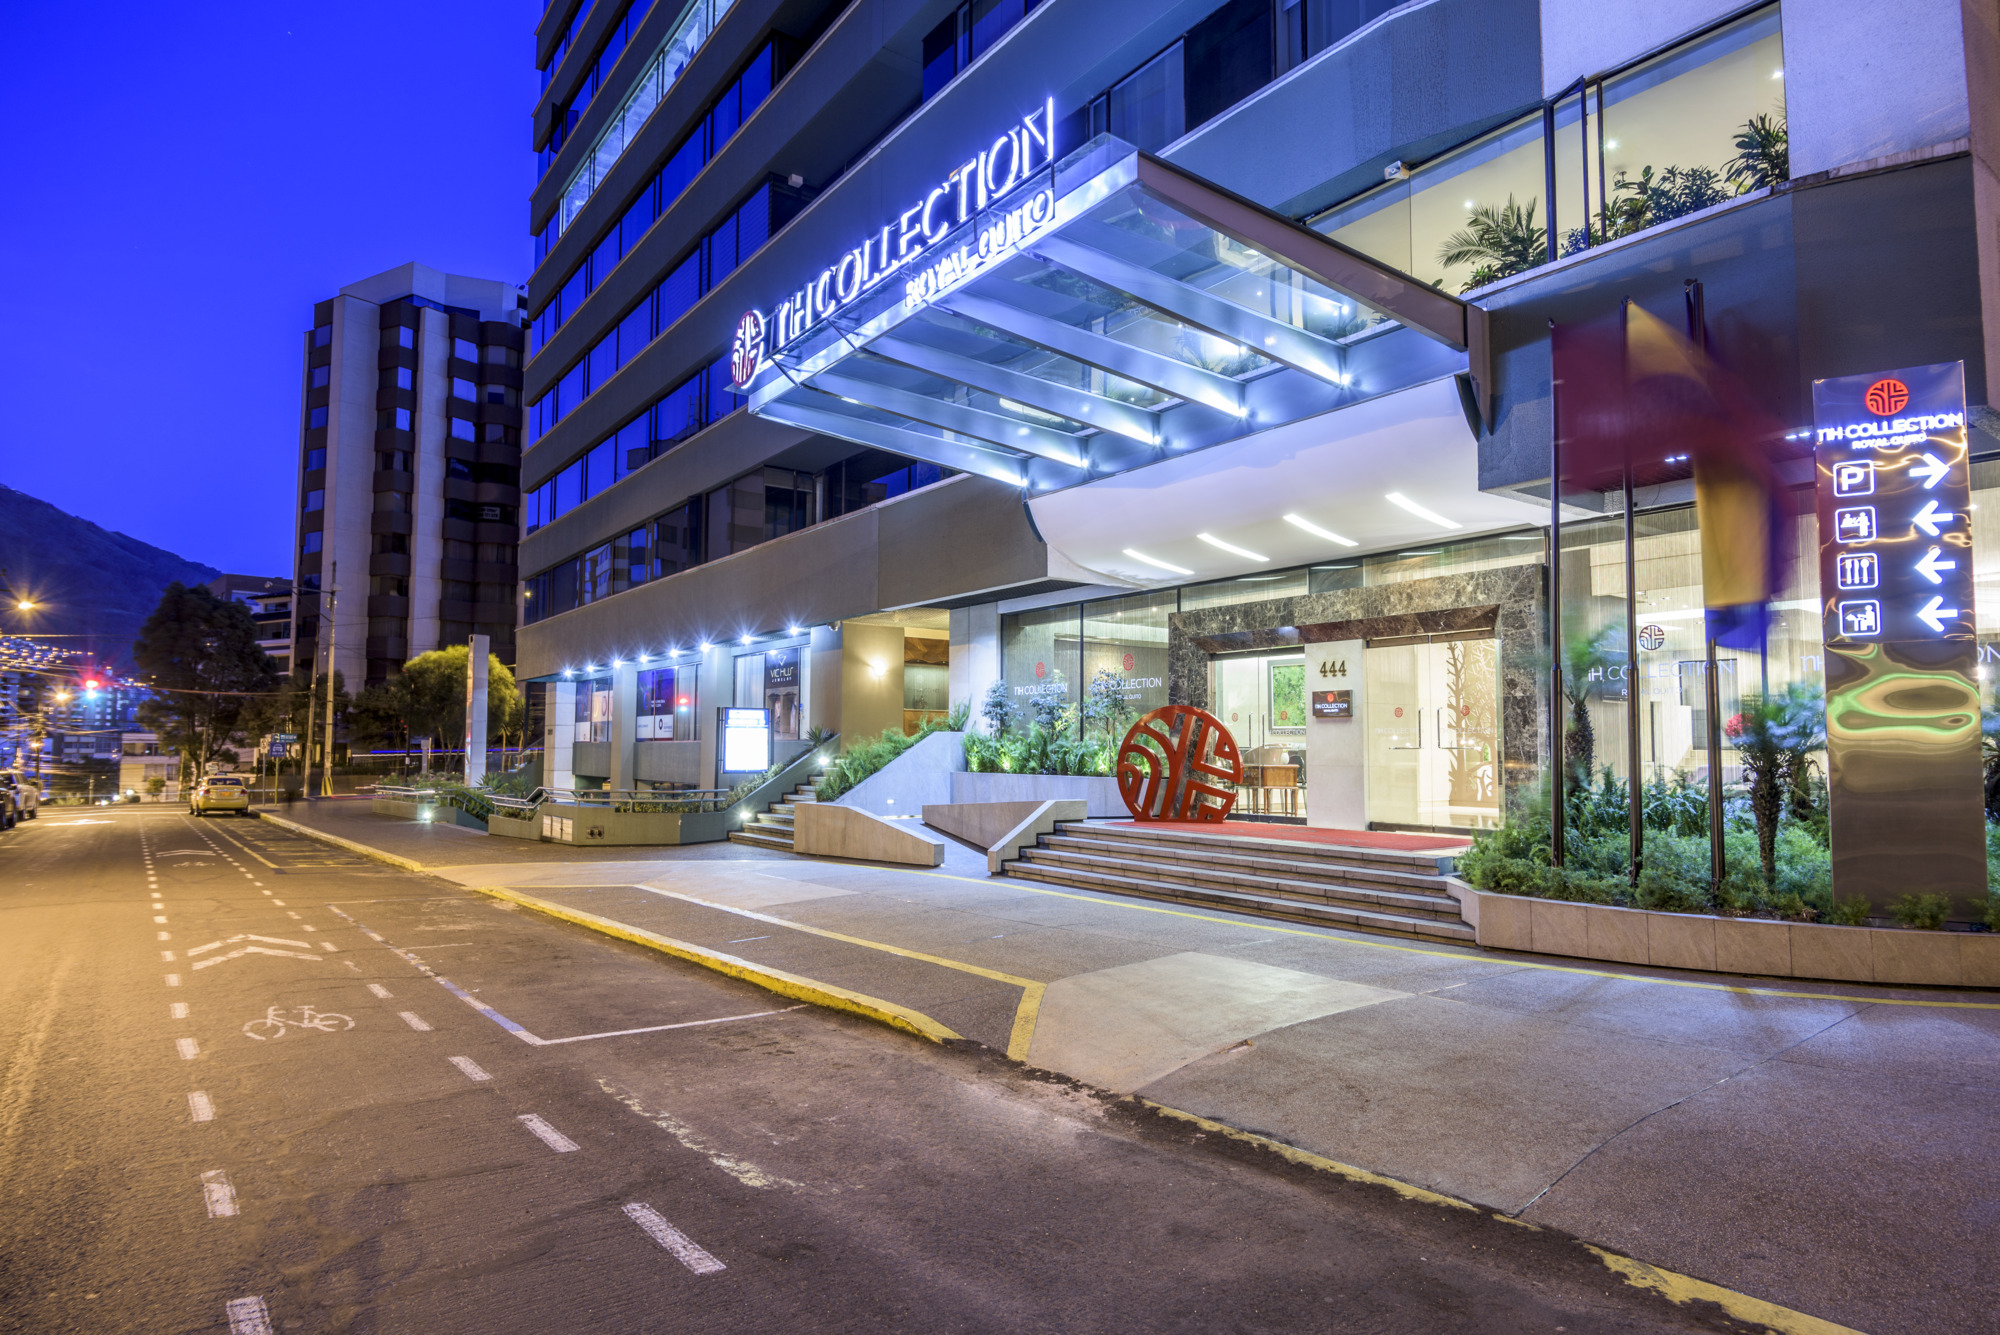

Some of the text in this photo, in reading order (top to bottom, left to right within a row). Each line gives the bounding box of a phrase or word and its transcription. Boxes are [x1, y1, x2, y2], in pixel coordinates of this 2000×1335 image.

[815, 97, 1054, 317] COLLECTION
[905, 188, 1054, 308] ROYAL QUITO
[1845, 412, 1964, 438] COLLECTION
[1852, 432, 1928, 449] ROYAL QUITO
[1320, 660, 1347, 678] 444
